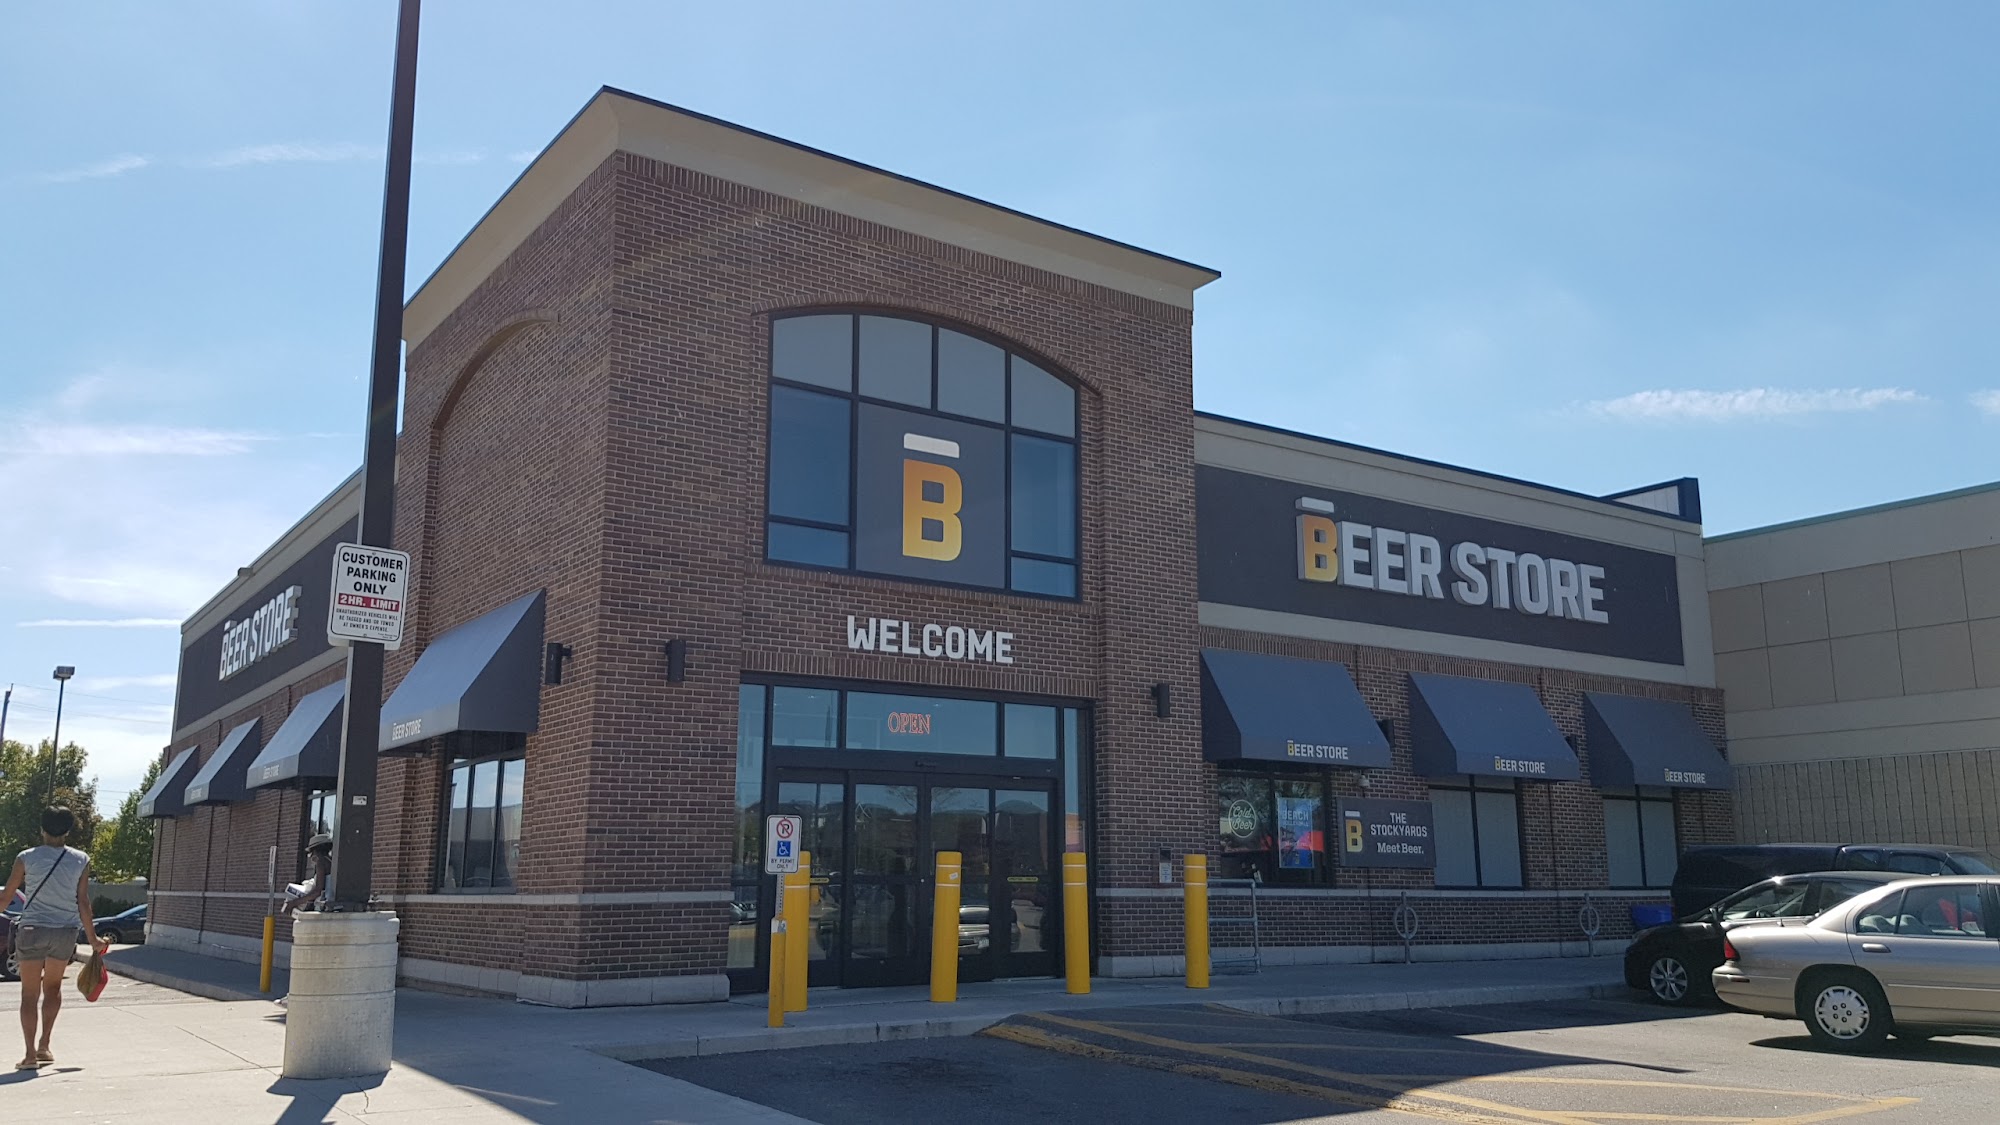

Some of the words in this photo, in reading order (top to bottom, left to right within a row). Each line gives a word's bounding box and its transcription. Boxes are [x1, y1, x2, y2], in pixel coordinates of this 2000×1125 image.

[903, 458, 963, 562] B
[342, 552, 403, 570] CUSTOMER
[1296, 497, 1444, 599] BEER
[1450, 541, 1609, 624] STORE
[347, 566, 396, 582] PARKING
[353, 581, 387, 595] ONLY
[340, 595, 366, 606] 2HR.
[370, 598, 398, 611] LIMIT
[336, 608, 367, 616] UNAUTHORIZED
[219, 620, 250, 681] BEER
[250, 585, 302, 663] STORE
[350, 622, 369, 630] OWNER'S
[847, 615, 1014, 664] WELCOME
[392, 722, 405, 741] BEER
[405, 718, 421, 738] STORE
[887, 711, 931, 734] OPEN
[1287, 740, 1314, 758] BEER
[1316, 745, 1348, 760] STORE
[1494, 756, 1517, 772] BEER
[1518, 760, 1546, 774] STORE
[1664, 768, 1683, 782] BEER
[1683, 771, 1706, 784] STORE
[1233, 805, 1254, 818] Cold
[1390, 812, 1407, 824] THE
[1231, 818, 1254, 830] Beer
[1370, 824, 1428, 837] STOCKYARDS
[1377, 842, 1401, 853] Meet
[1401, 843, 1424, 855] Beer.
